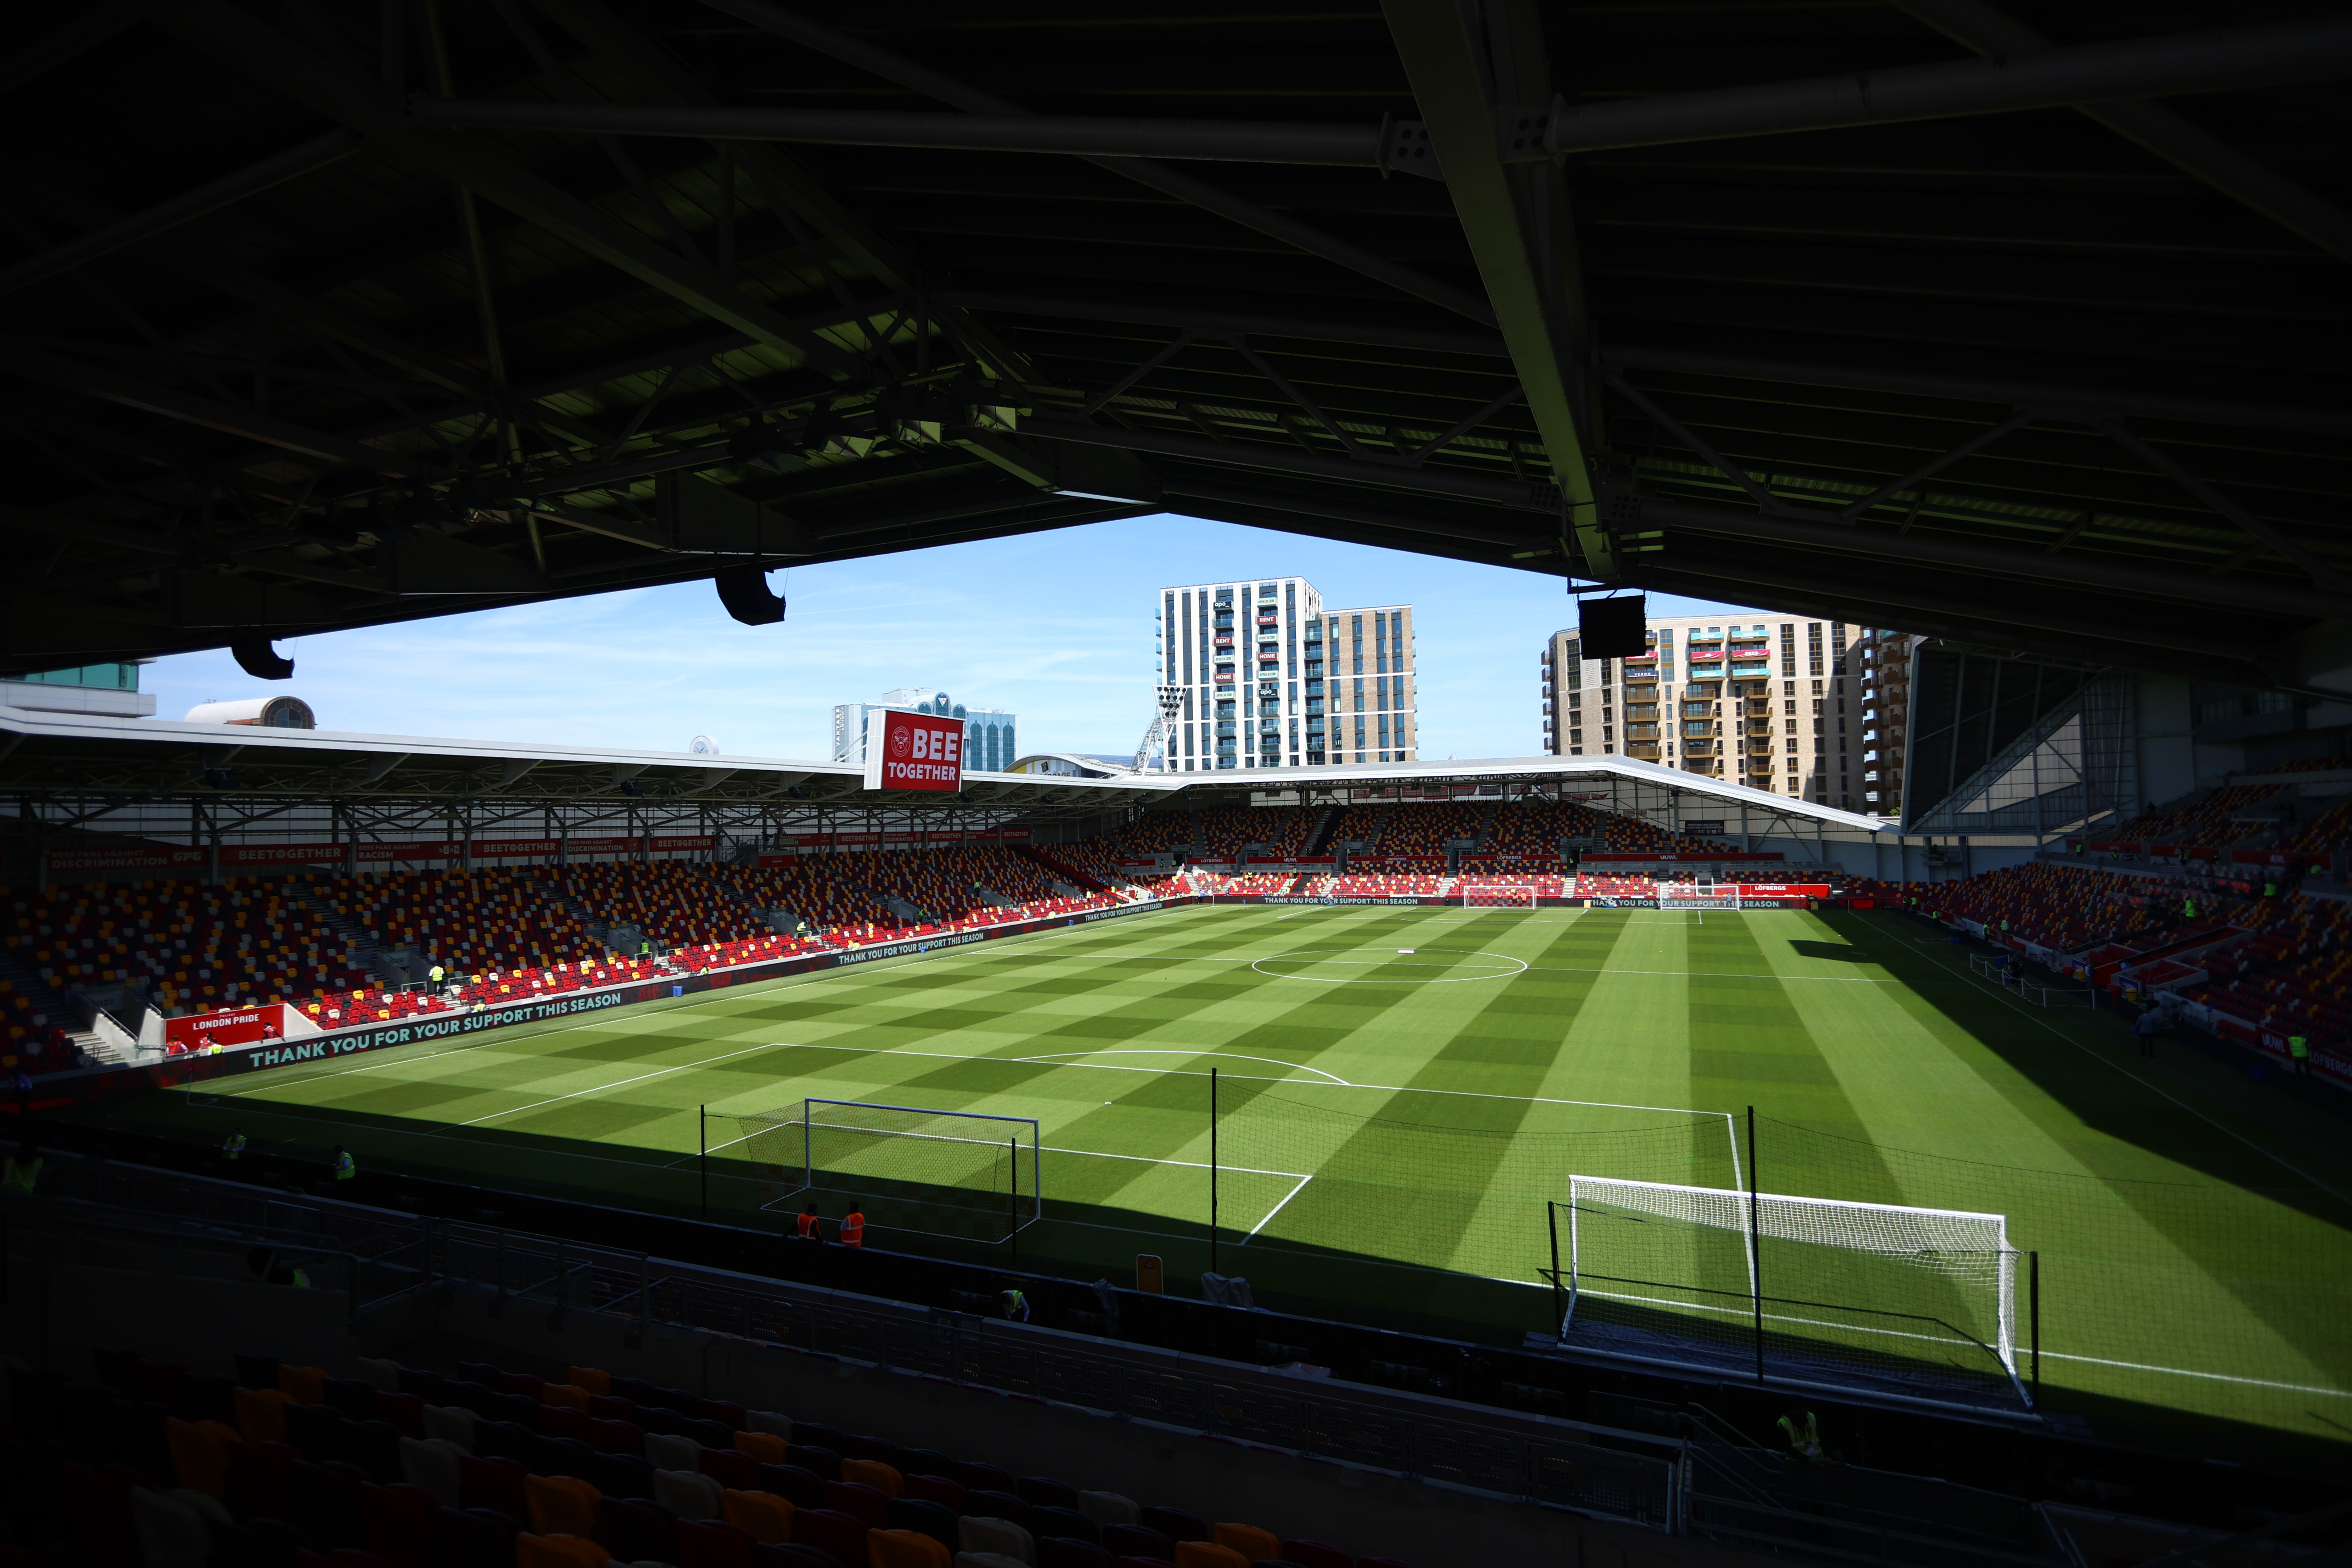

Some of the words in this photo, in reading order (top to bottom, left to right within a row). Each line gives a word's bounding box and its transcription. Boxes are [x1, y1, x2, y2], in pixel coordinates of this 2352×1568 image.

[912, 728, 958, 761] BEE
[888, 762, 956, 780] TOGETHER
[484, 843, 555, 853] BEETOGETHER
[658, 839, 711, 847] BEETOGETHER
[238, 848, 341, 860] BEETOGETHER
[439, 845, 460, 854] bias
[52, 857, 168, 868] DISCRIMINATION
[173, 852, 202, 862] GPG
[839, 952, 866, 964] THANK
[867, 950, 882, 959] YOU
[884, 947, 897, 956] FOR
[899, 944, 917, 955] YOUR
[918, 938, 946, 950] SUPPORT
[947, 936, 961, 946] THIS
[962, 932, 983, 943] SEASON
[193, 1016, 231, 1030] LONDON
[234, 1014, 259, 1024] PRIDE
[250, 1042, 326, 1067] THANK
[330, 1035, 370, 1054] YOU
[375, 1023, 410, 1046] FOR
[415, 1021, 460, 1039] YOUR
[465, 1007, 533, 1031] SUPPORT
[536, 1001, 568, 1018] THIS
[571, 993, 621, 1012] SEASON
